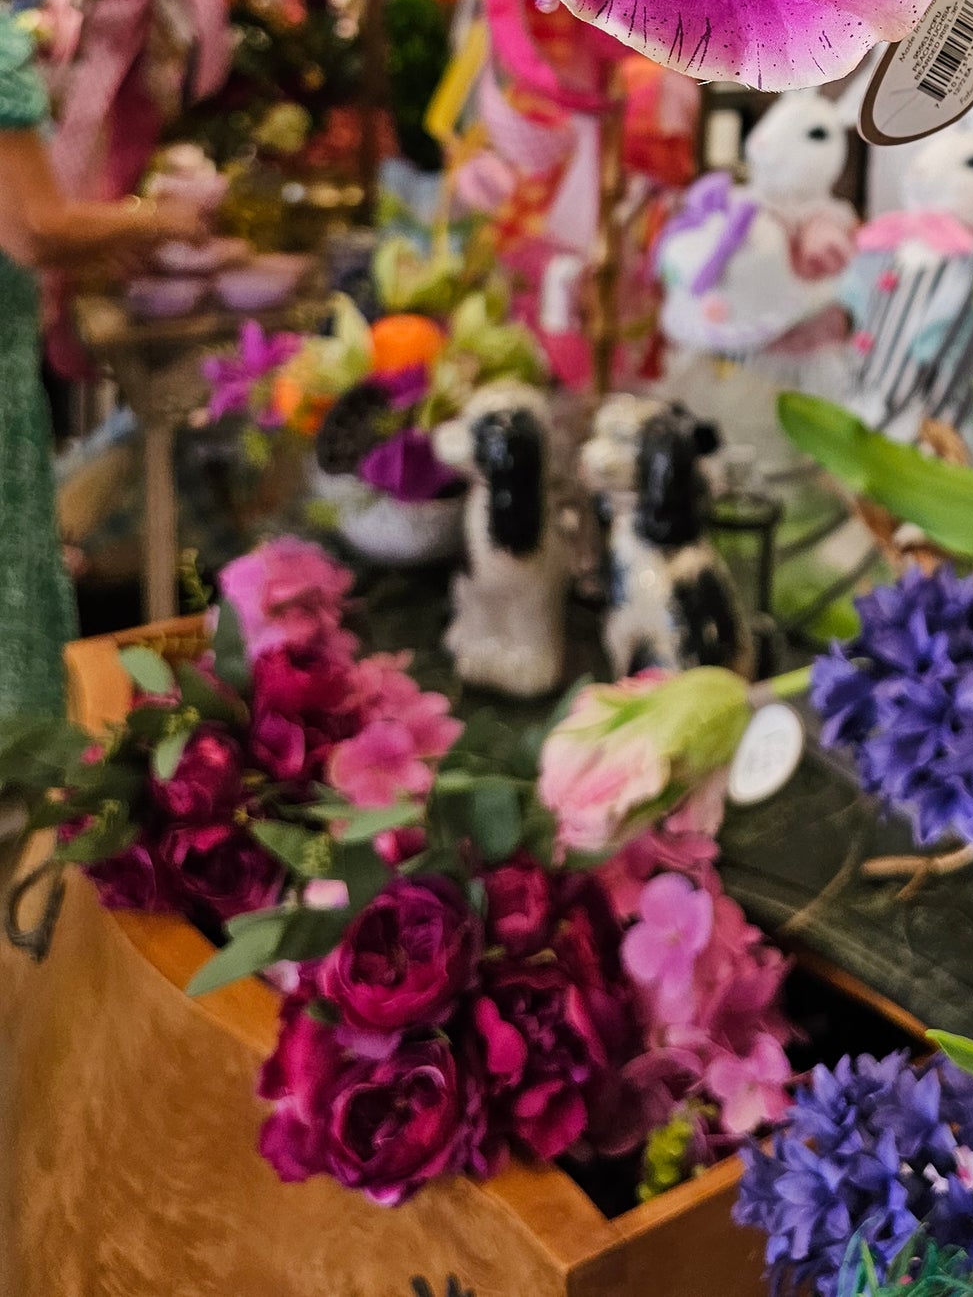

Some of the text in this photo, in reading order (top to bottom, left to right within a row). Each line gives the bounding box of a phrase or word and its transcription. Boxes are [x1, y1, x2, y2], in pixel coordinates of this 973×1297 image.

[897, 35, 916, 62] Made
[912, 24, 921, 34] In
[911, 4, 951, 72] PEACH/FUCHSIA
[913, 40, 941, 81] BEARDED
[937, 22, 949, 40] IRIS
